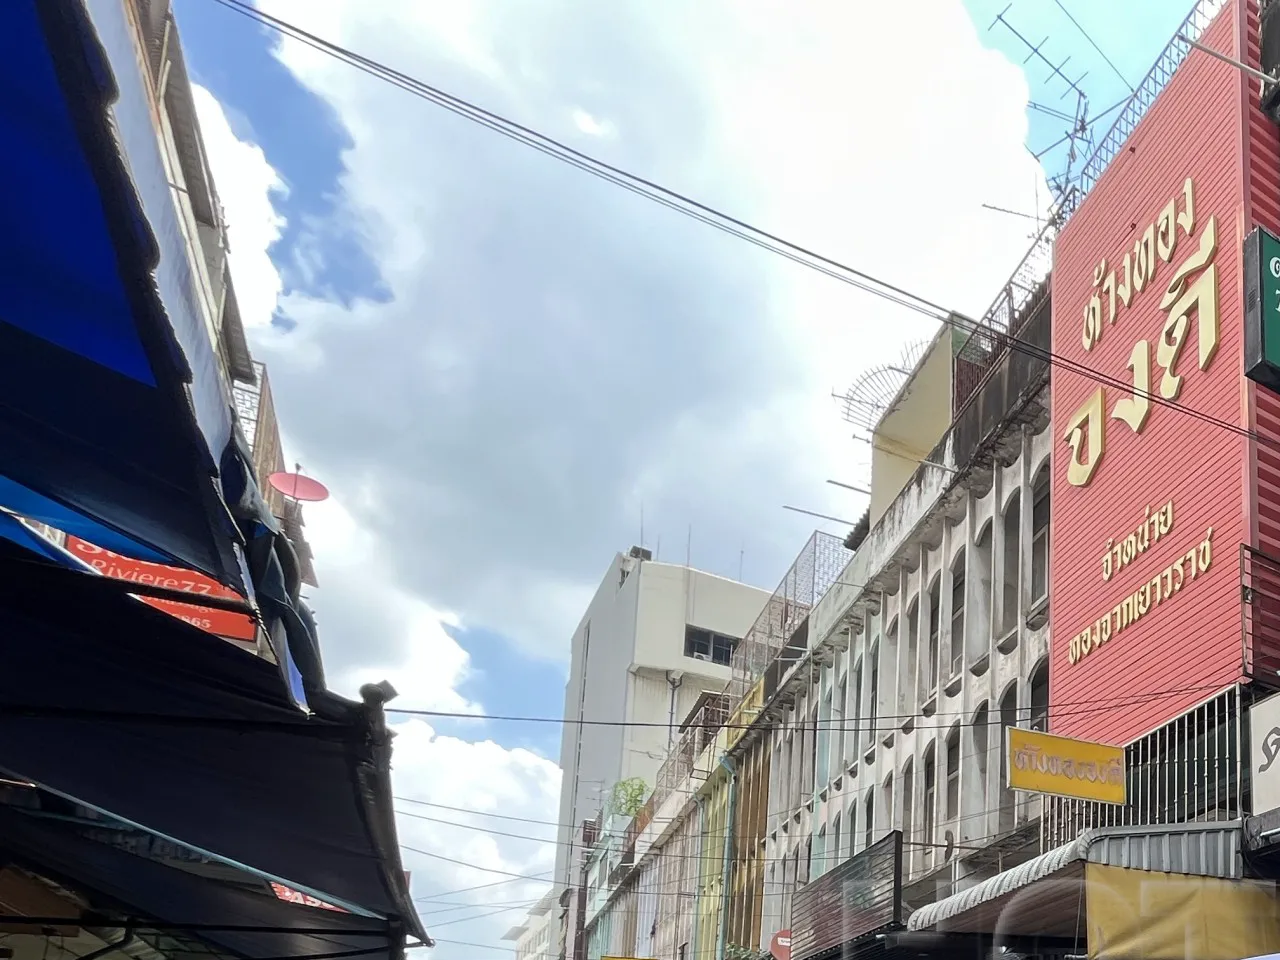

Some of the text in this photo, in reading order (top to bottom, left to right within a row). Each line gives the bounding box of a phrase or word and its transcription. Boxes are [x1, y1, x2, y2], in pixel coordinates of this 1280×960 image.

[1082, 177, 1195, 351] ห้างทอง
[1102, 499, 1174, 582] จำหน่าย
